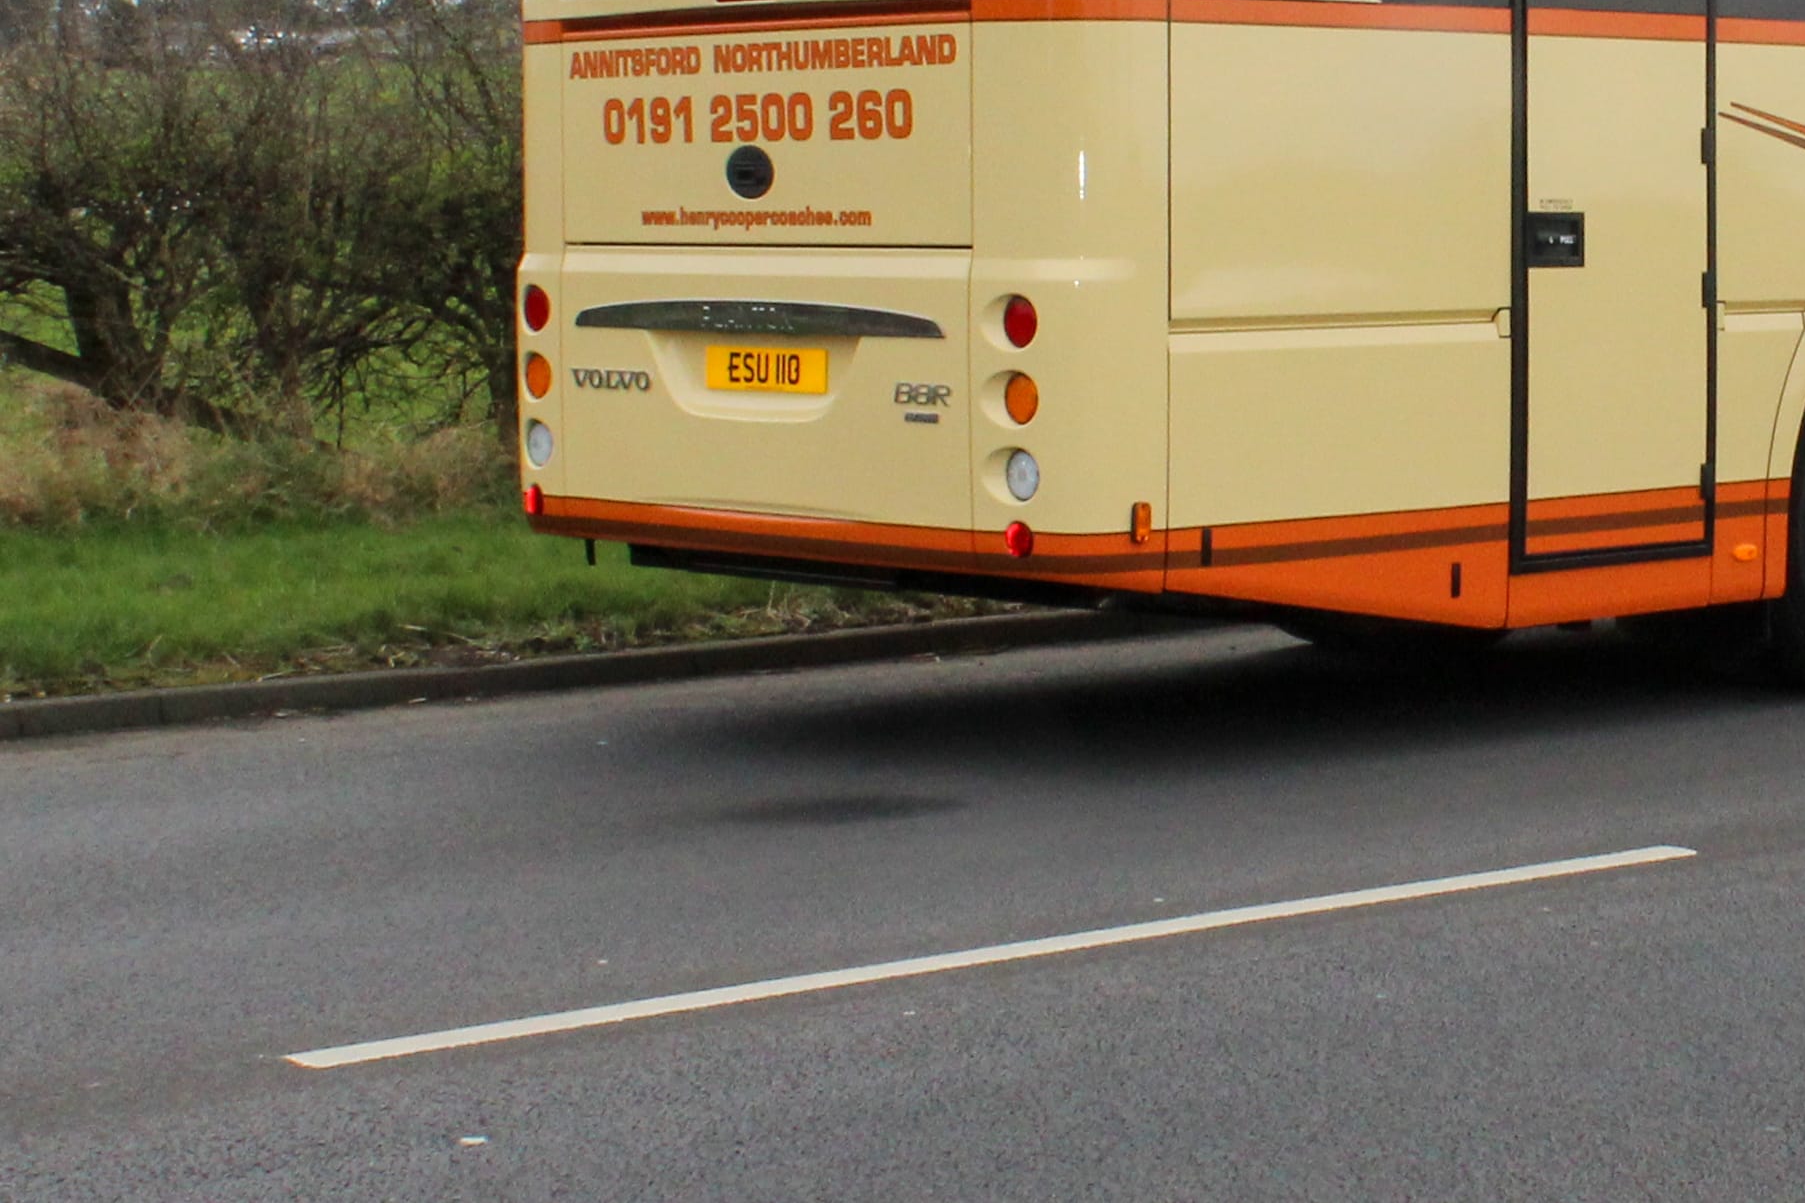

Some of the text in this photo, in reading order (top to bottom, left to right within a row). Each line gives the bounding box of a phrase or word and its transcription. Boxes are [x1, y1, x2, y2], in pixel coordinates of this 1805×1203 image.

[569, 33, 957, 79] ANNITSFORD NORTHUMBERLAND
[603, 88, 913, 145] 0191 2500 260
[571, 368, 651, 391] VOLVO
[728, 351, 770, 384] ESU
